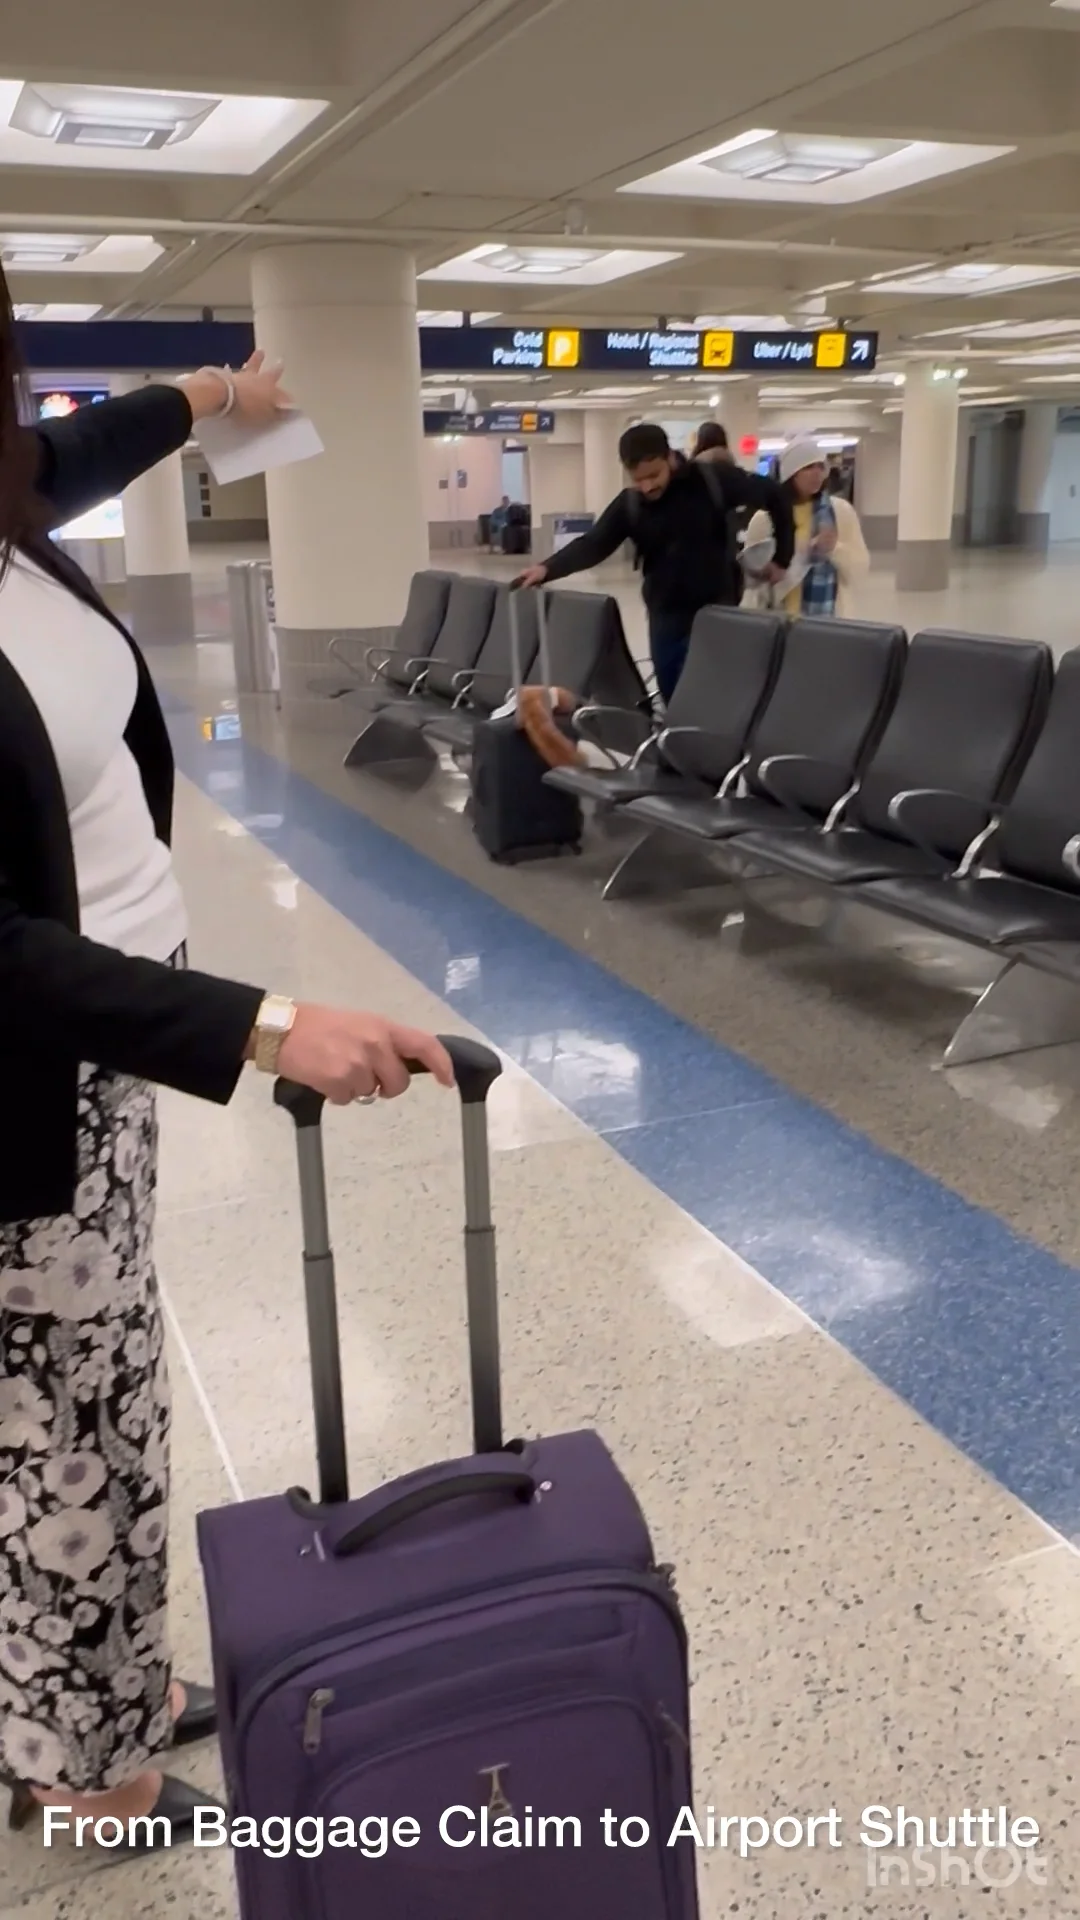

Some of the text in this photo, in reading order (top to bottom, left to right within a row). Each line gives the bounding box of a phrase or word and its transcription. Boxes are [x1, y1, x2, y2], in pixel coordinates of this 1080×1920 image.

[513, 331, 544, 348] Gold
[607, 332, 640, 349] Hotel
[649, 332, 699, 351] Regional
[493, 347, 543, 368] Parking
[649, 349, 698, 366] Shuttles
[754, 341, 783, 359] Uber
[790, 341, 813, 361] Lyft
